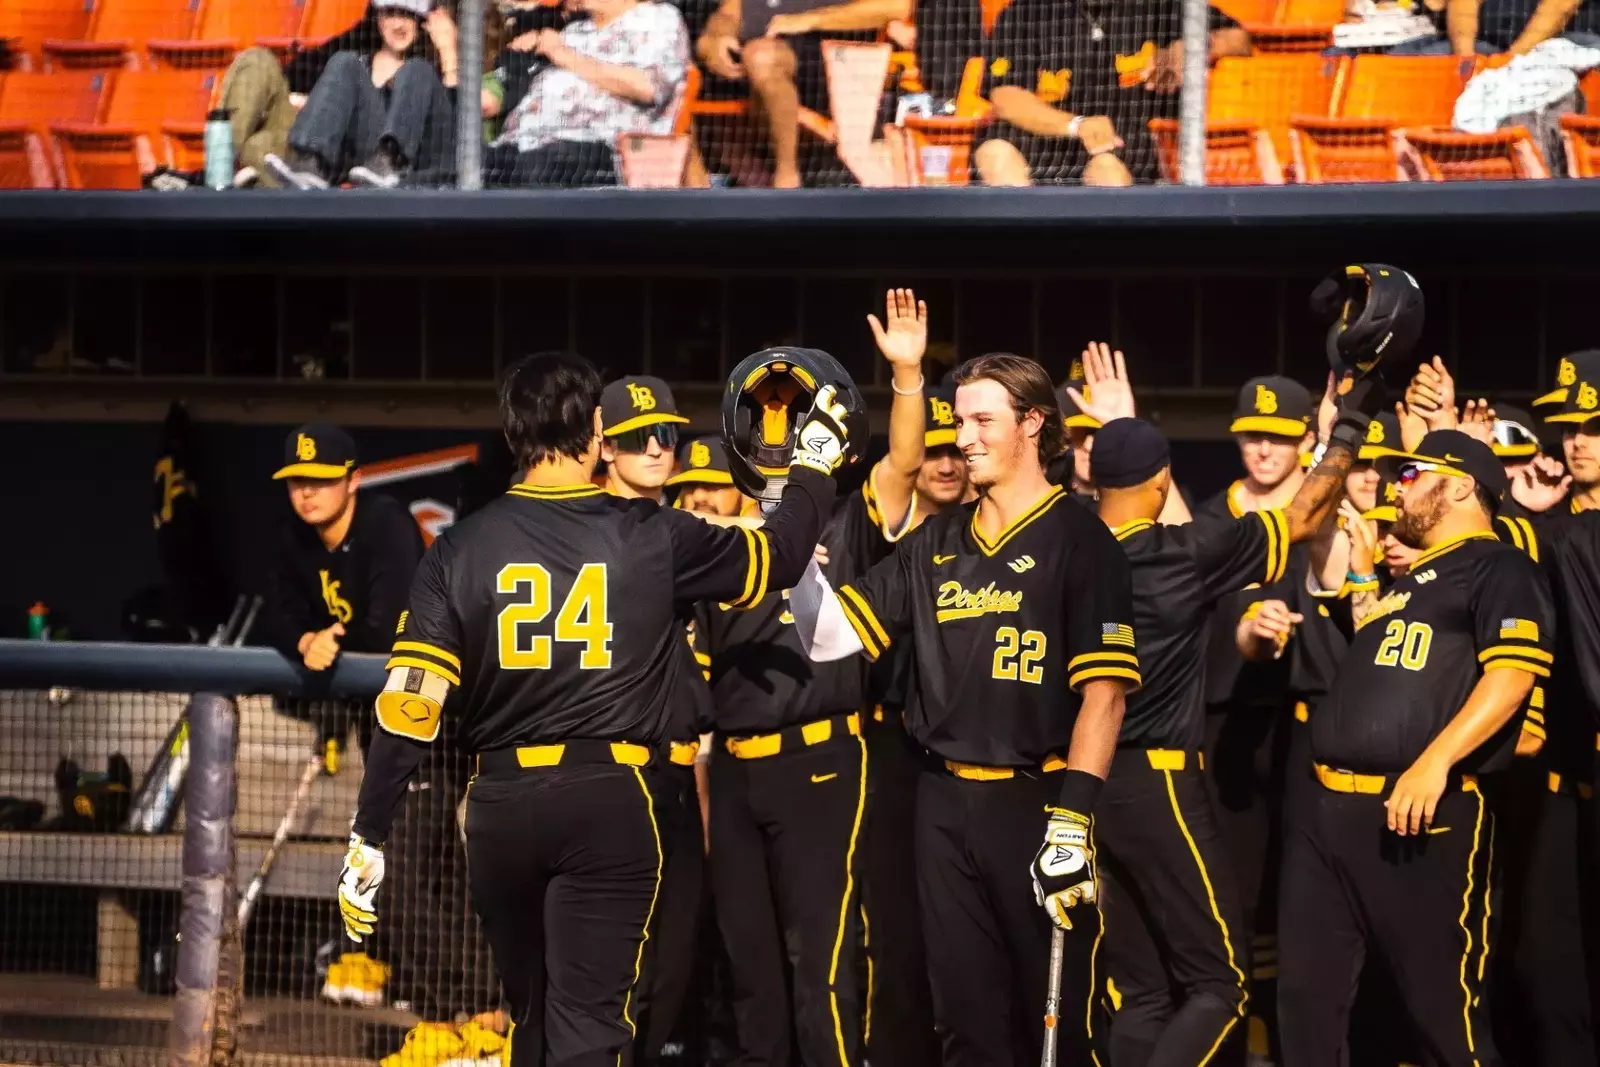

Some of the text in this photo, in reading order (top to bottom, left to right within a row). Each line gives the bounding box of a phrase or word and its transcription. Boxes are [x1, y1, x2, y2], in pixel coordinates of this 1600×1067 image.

[627, 383, 656, 411] LB
[1255, 384, 1278, 414] LB
[1575, 381, 1598, 410] LB
[1366, 420, 1385, 443] B
[296, 433, 316, 460] LB
[496, 563, 613, 669] 24
[992, 627, 1047, 684] 22
[1374, 619, 1433, 671] 20
